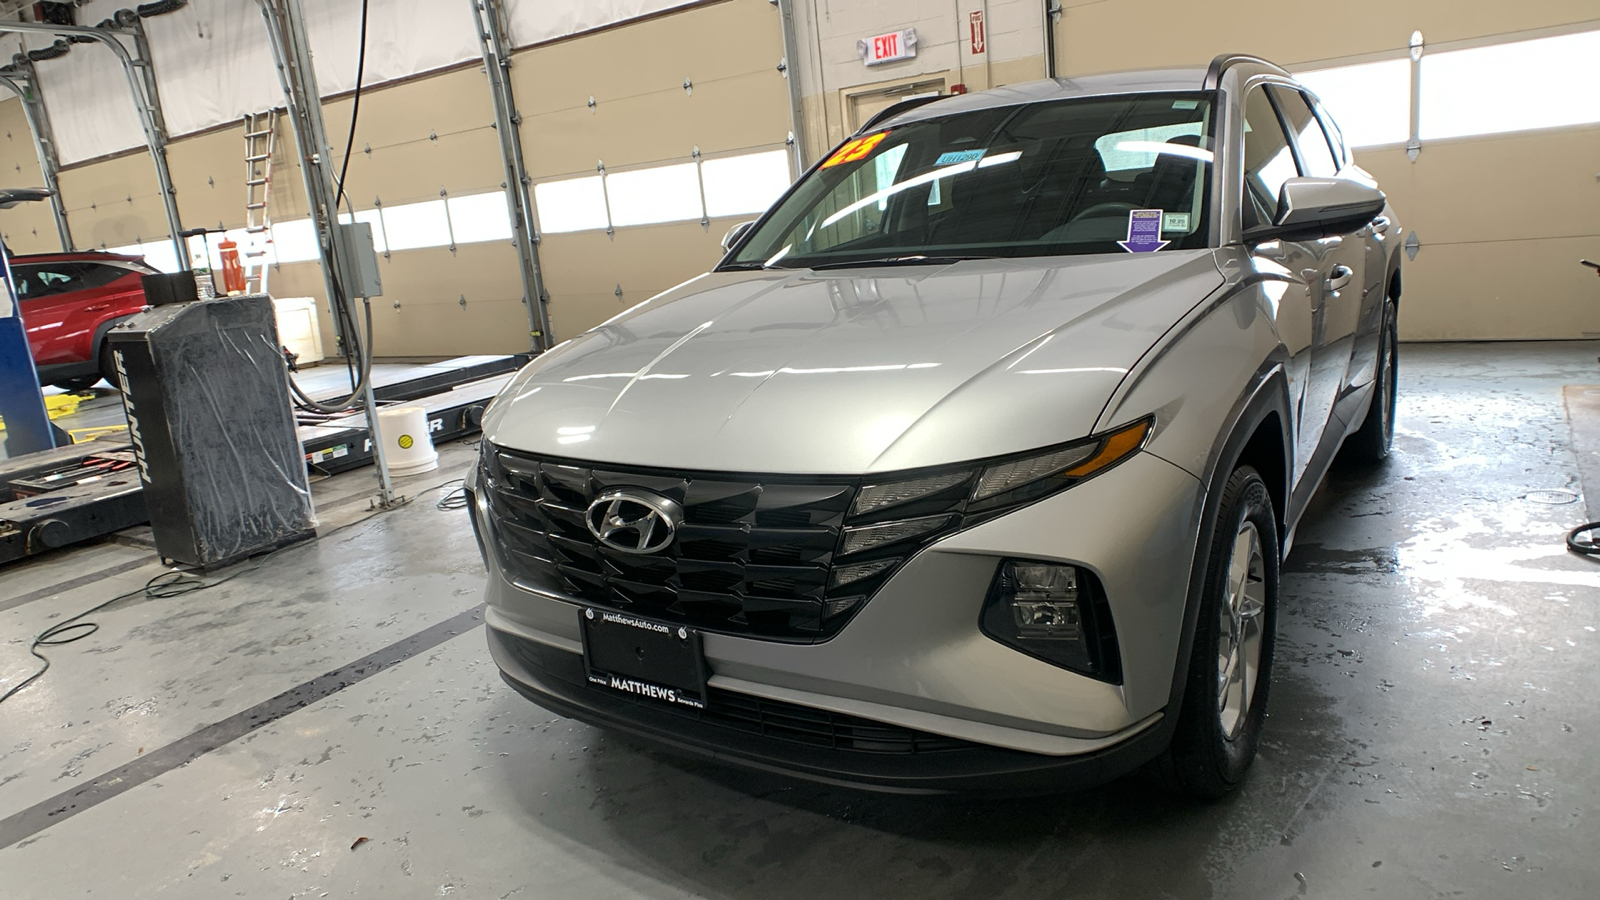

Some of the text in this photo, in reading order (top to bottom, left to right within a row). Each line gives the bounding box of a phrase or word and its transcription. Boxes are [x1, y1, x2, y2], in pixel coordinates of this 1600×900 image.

[874, 34, 898, 60] EXIT
[821, 131, 888, 169] 23
[941, 152, 979, 163] UH1290
[113, 350, 152, 484] HUNTER
[603, 613, 669, 634] MatthewsAuto.com
[611, 677, 676, 703] MATTHEWS
